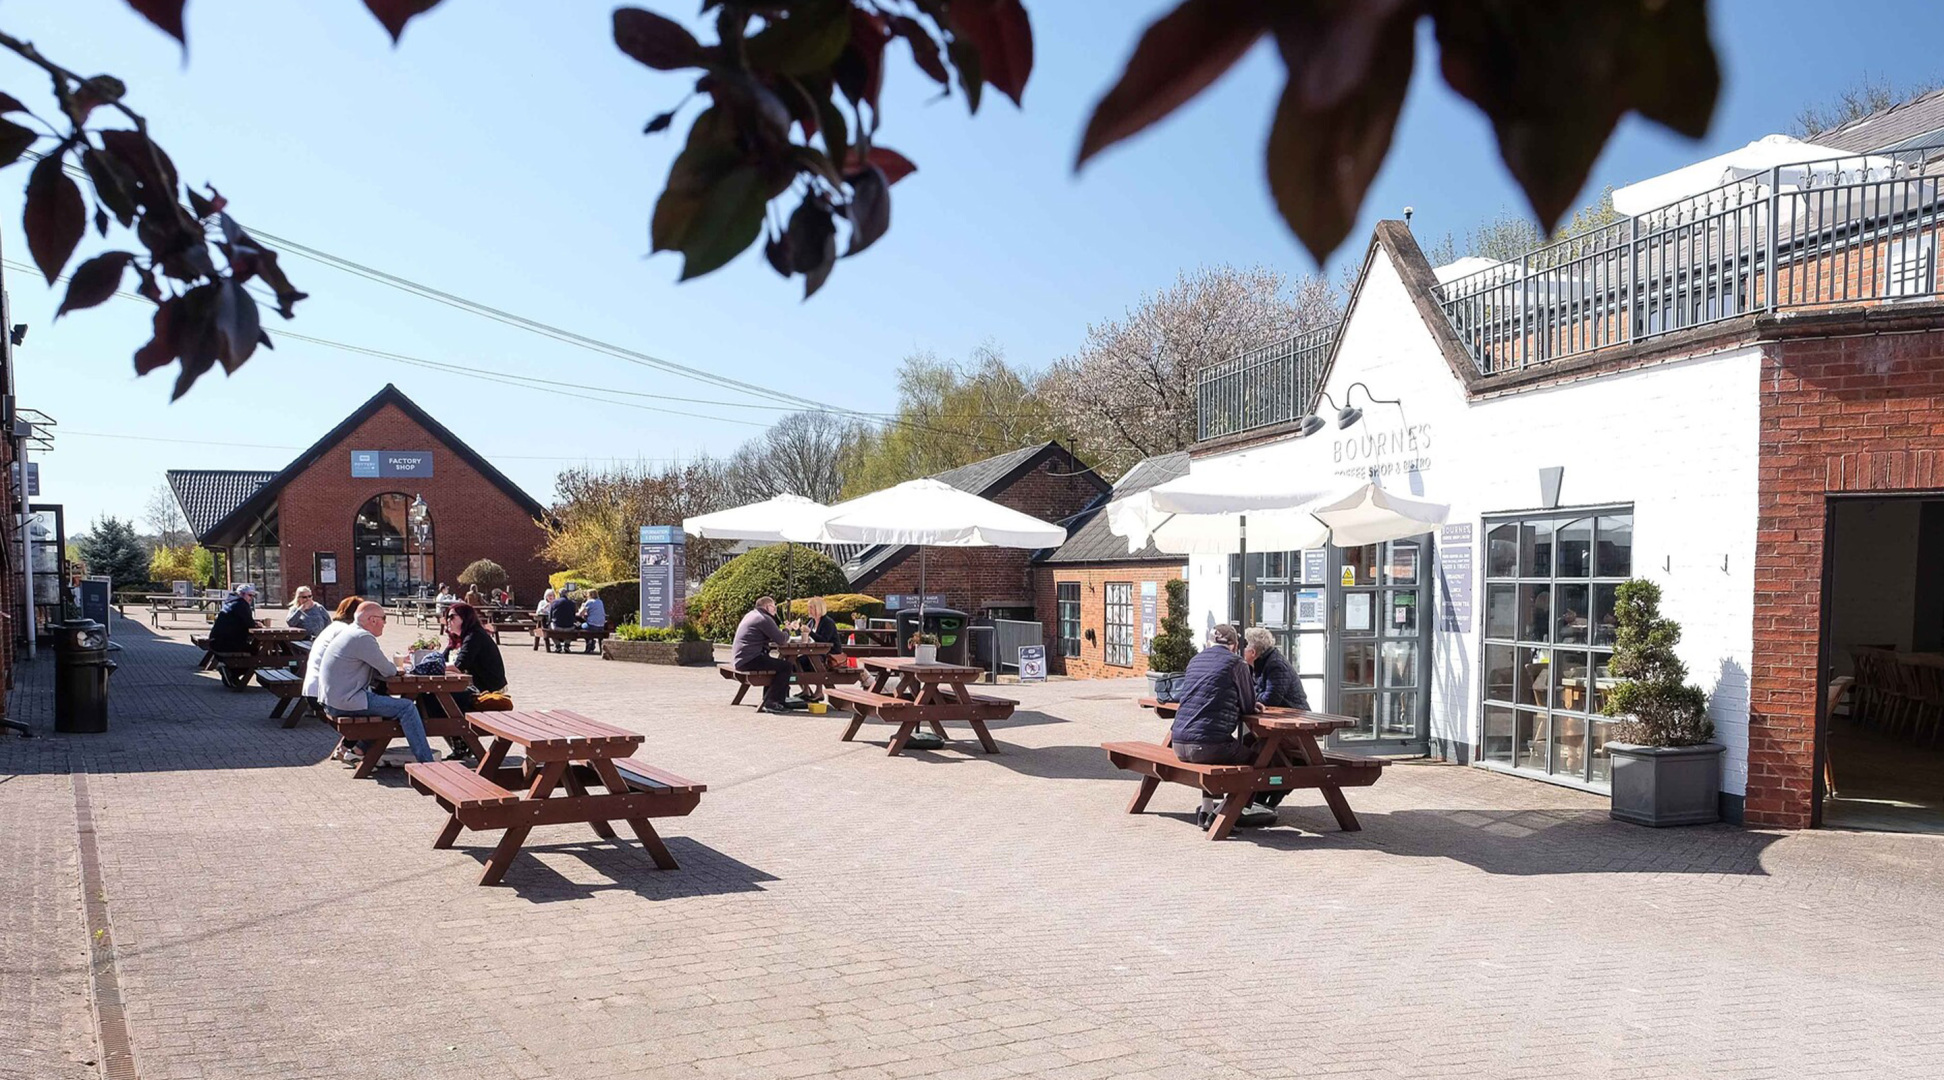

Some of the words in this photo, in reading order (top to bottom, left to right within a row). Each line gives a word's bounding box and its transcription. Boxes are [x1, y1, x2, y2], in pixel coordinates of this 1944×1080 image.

[1333, 424, 1431, 463] BOURNE'S
[1369, 463, 1393, 478] SHOP
[1403, 457, 1431, 471] BISTRO
